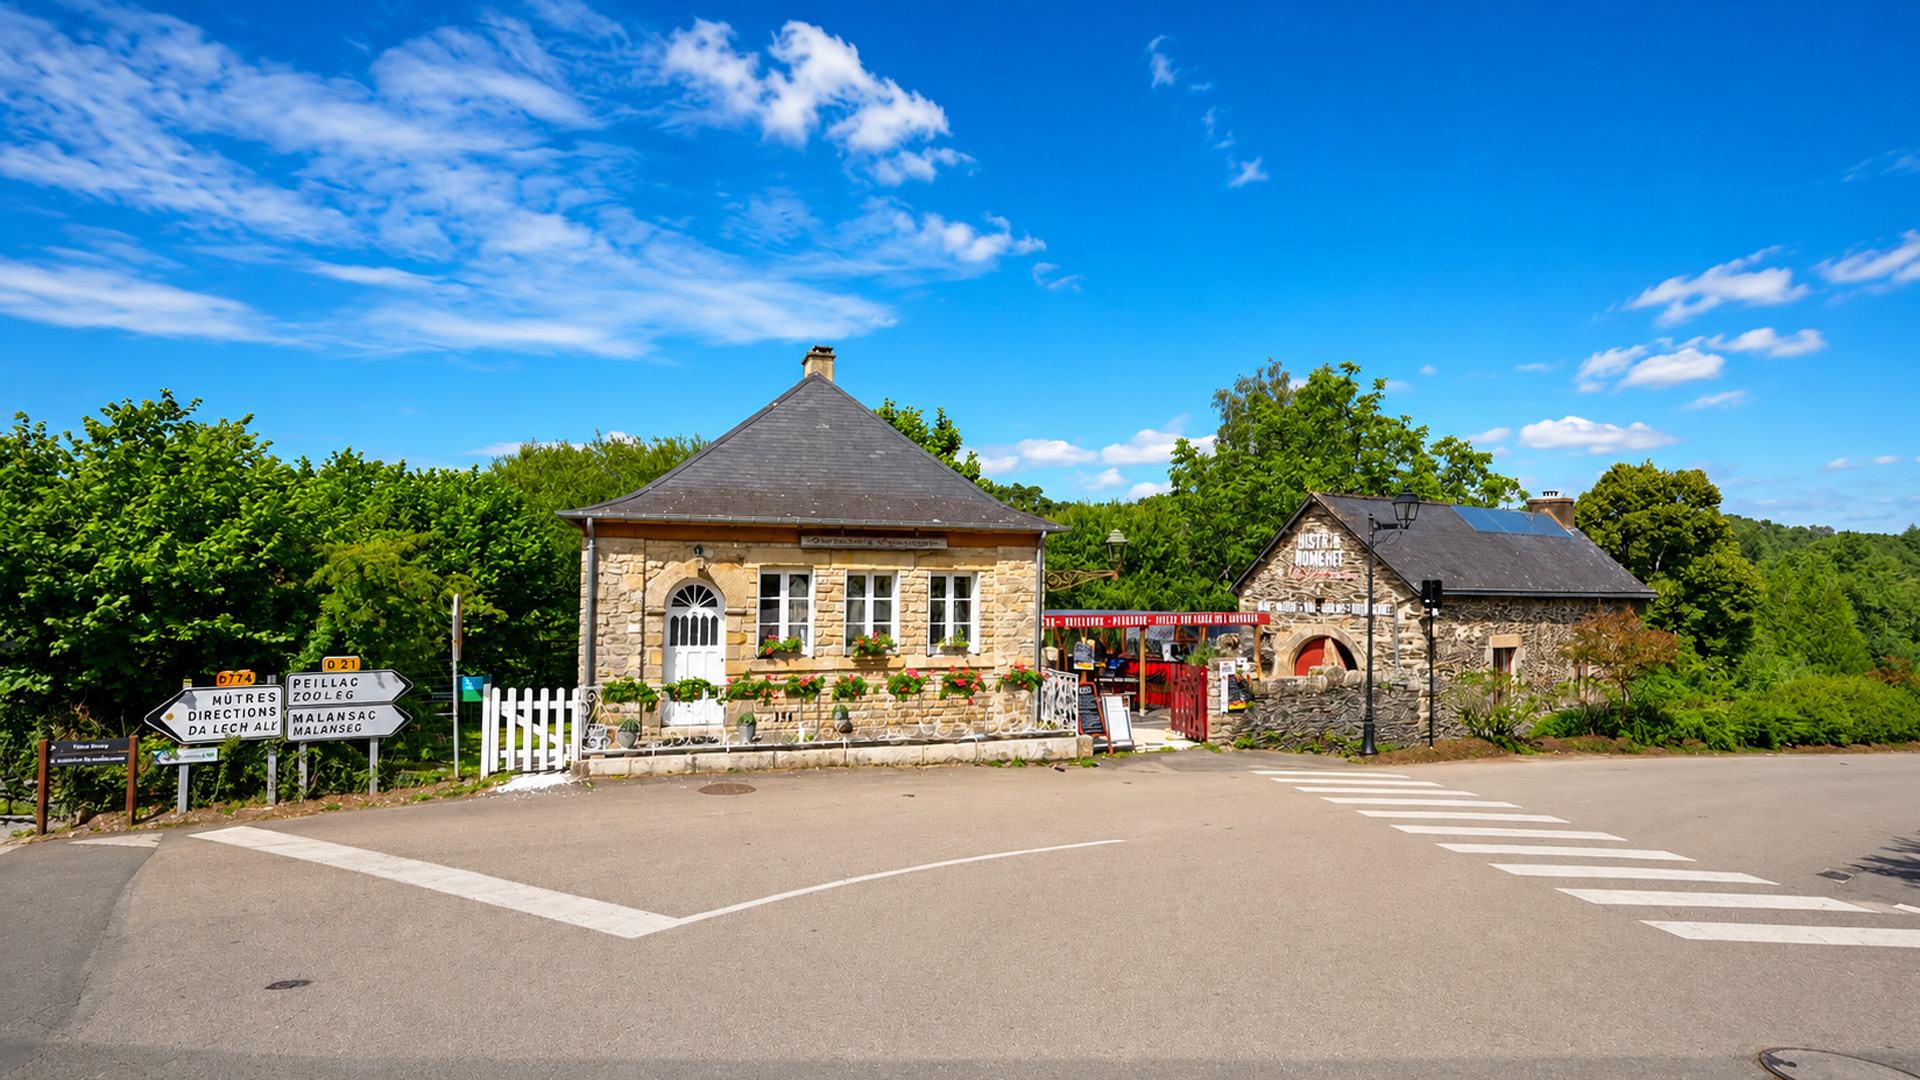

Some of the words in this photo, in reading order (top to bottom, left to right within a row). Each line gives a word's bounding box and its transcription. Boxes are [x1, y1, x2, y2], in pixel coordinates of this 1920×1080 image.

[340, 660, 355, 669] 21
[293, 677, 358, 689] PEILLAC
[212, 692, 276, 706] MÛTRES
[293, 690, 354, 702] ZOOLEG
[188, 706, 276, 721] DIRECTIONS
[292, 710, 376, 723] MALANSAC
[213, 722, 248, 734] LECH
